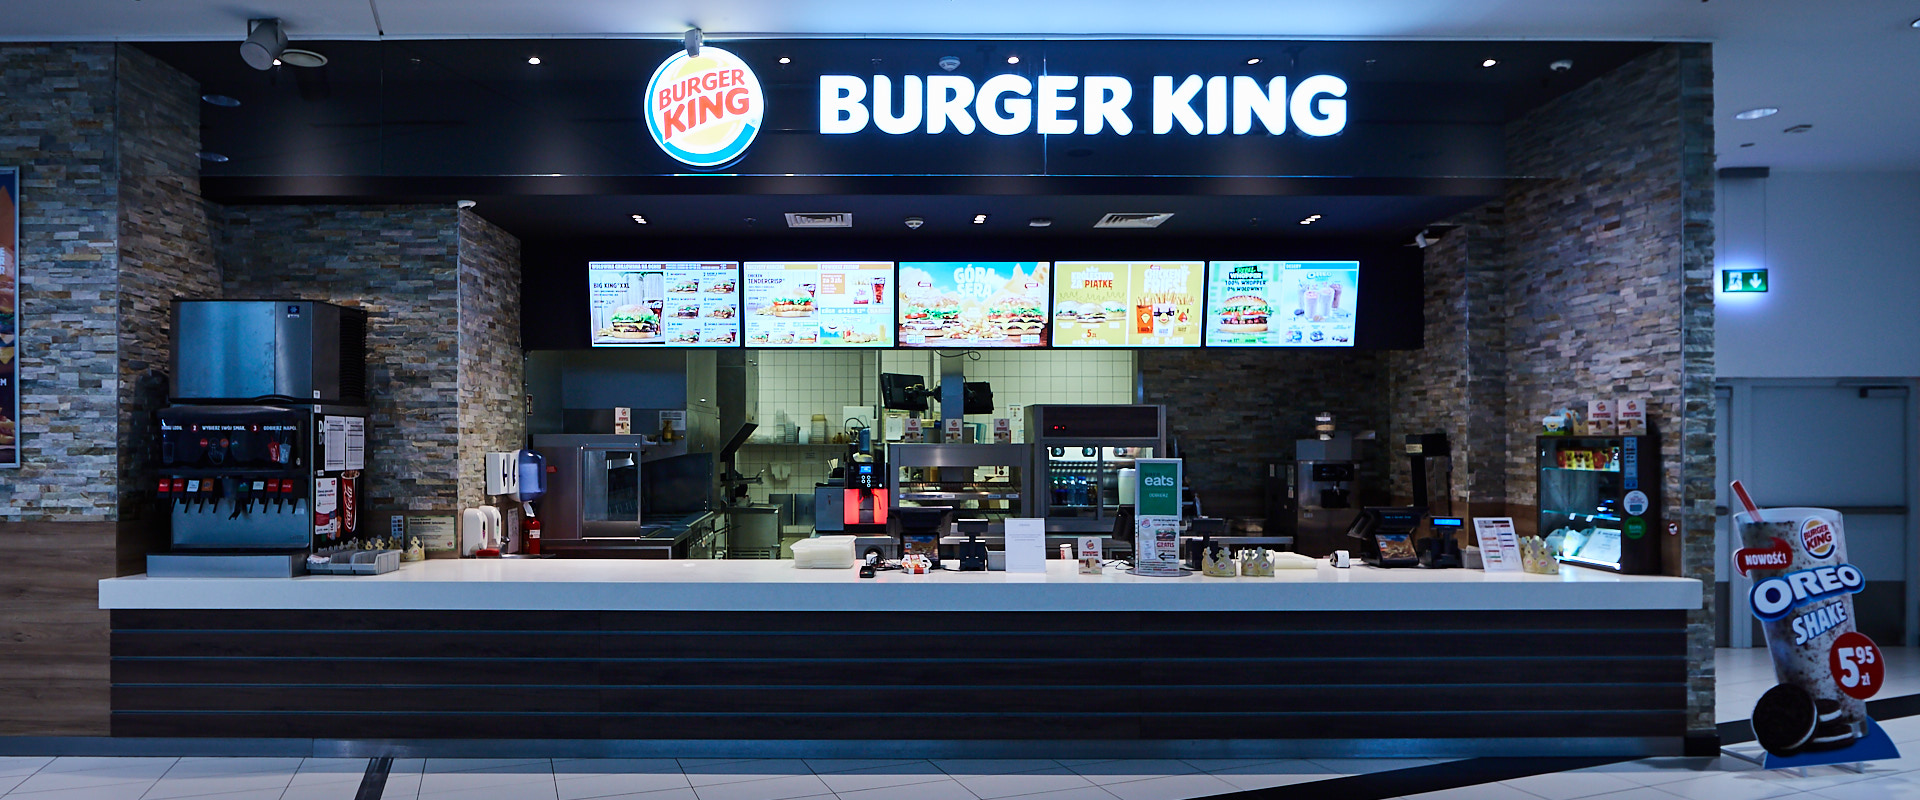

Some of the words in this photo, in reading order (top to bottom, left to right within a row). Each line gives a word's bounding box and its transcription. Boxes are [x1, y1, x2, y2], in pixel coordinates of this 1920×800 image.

[659, 69, 745, 111] BURGER
[663, 87, 750, 140] KING
[819, 74, 1133, 137] BURGER
[1153, 74, 1348, 137] KING
[953, 264, 995, 284] GÓRA
[957, 283, 992, 299] SERA
[1084, 279, 1113, 291] PIĄTKĘ
[1086, 328, 1092, 338] 5
[1144, 475, 1174, 487] eats
[1803, 524, 1829, 541] BURGER
[1806, 531, 1832, 551] KING
[1744, 551, 1787, 566] NOWOŚĆ!
[1753, 565, 1861, 615] OREO
[1791, 600, 1848, 646] SHAKE
